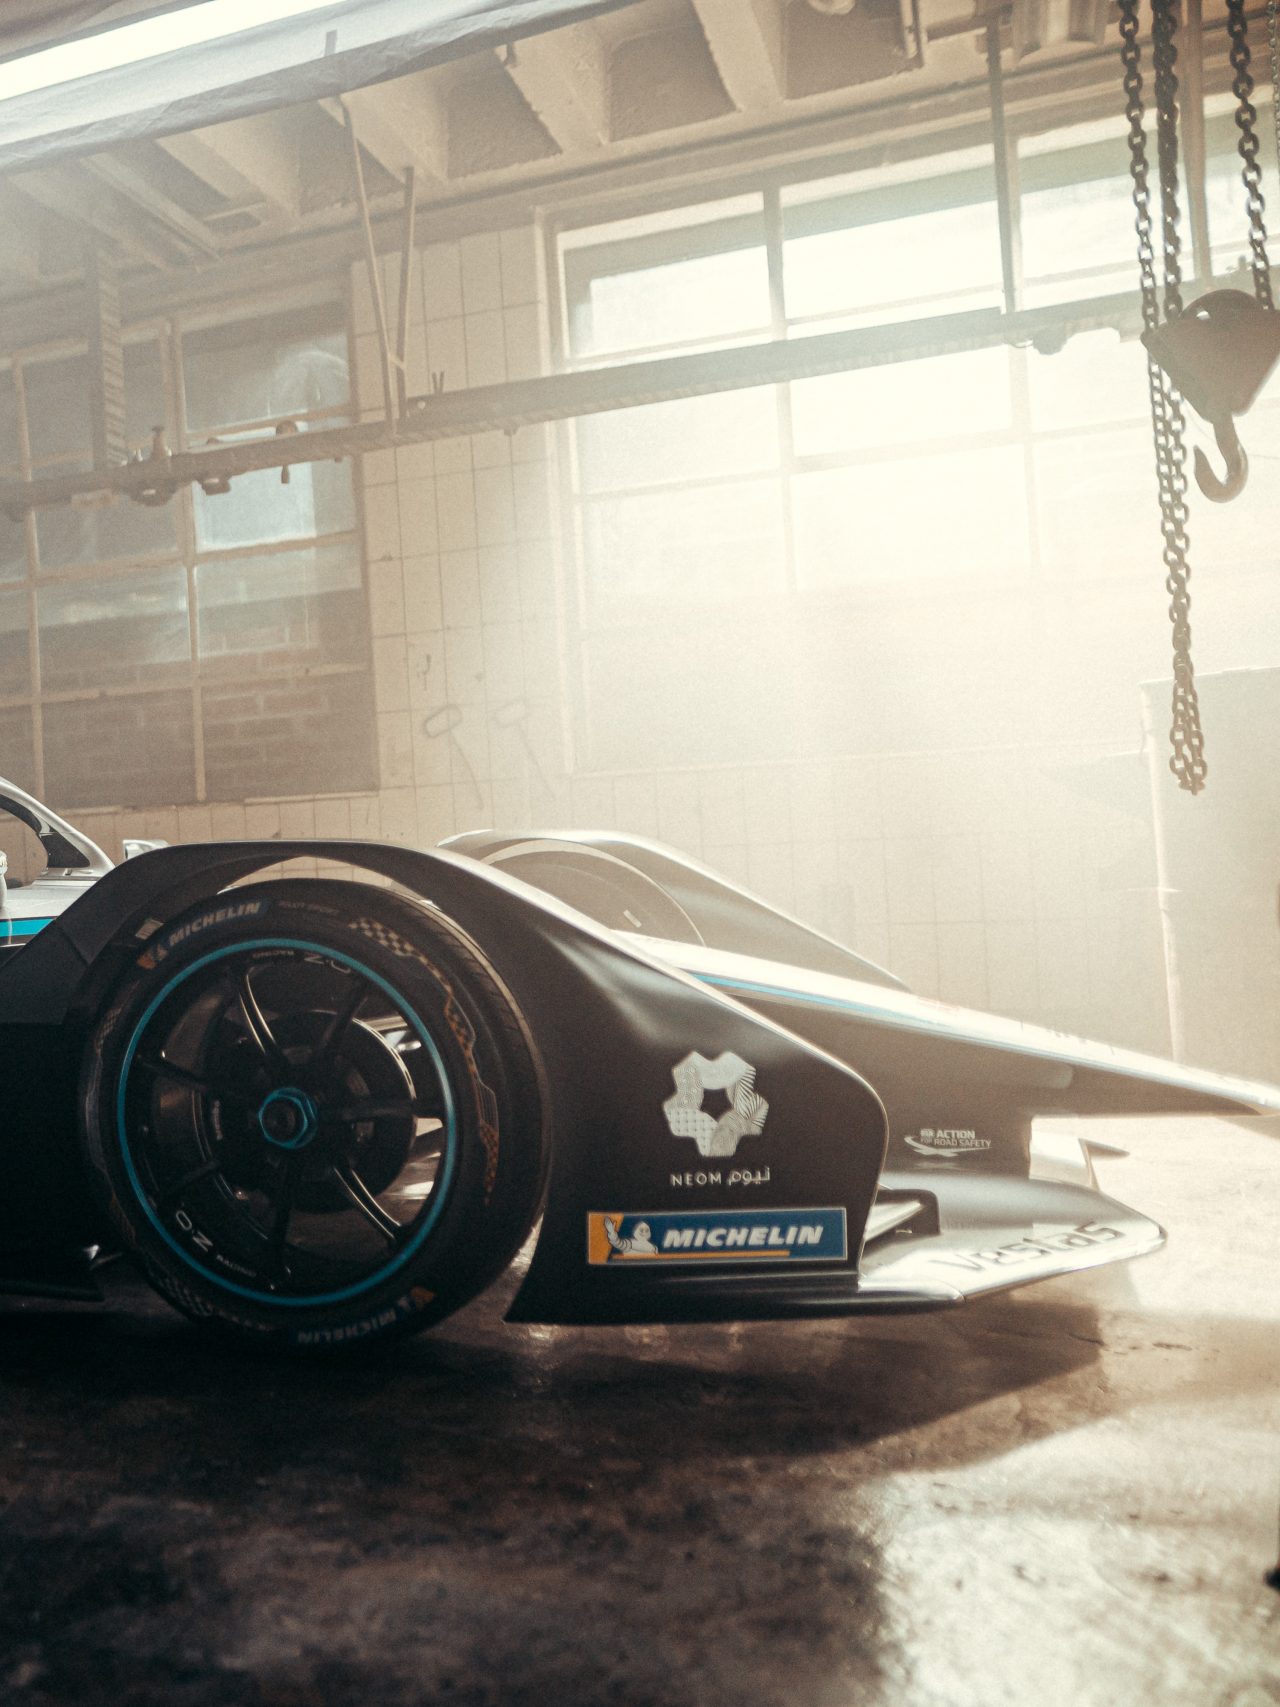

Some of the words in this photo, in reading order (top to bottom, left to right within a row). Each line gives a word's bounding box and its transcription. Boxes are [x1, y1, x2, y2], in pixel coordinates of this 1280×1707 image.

[169, 901, 261, 946] MICHELIN
[936, 1130, 976, 1140] ACTION
[934, 1138, 958, 1146] ROAD
[959, 1139, 992, 1149] SAFETY
[670, 1171, 722, 1187] NEOM
[663, 1225, 824, 1249] MICHELIN
